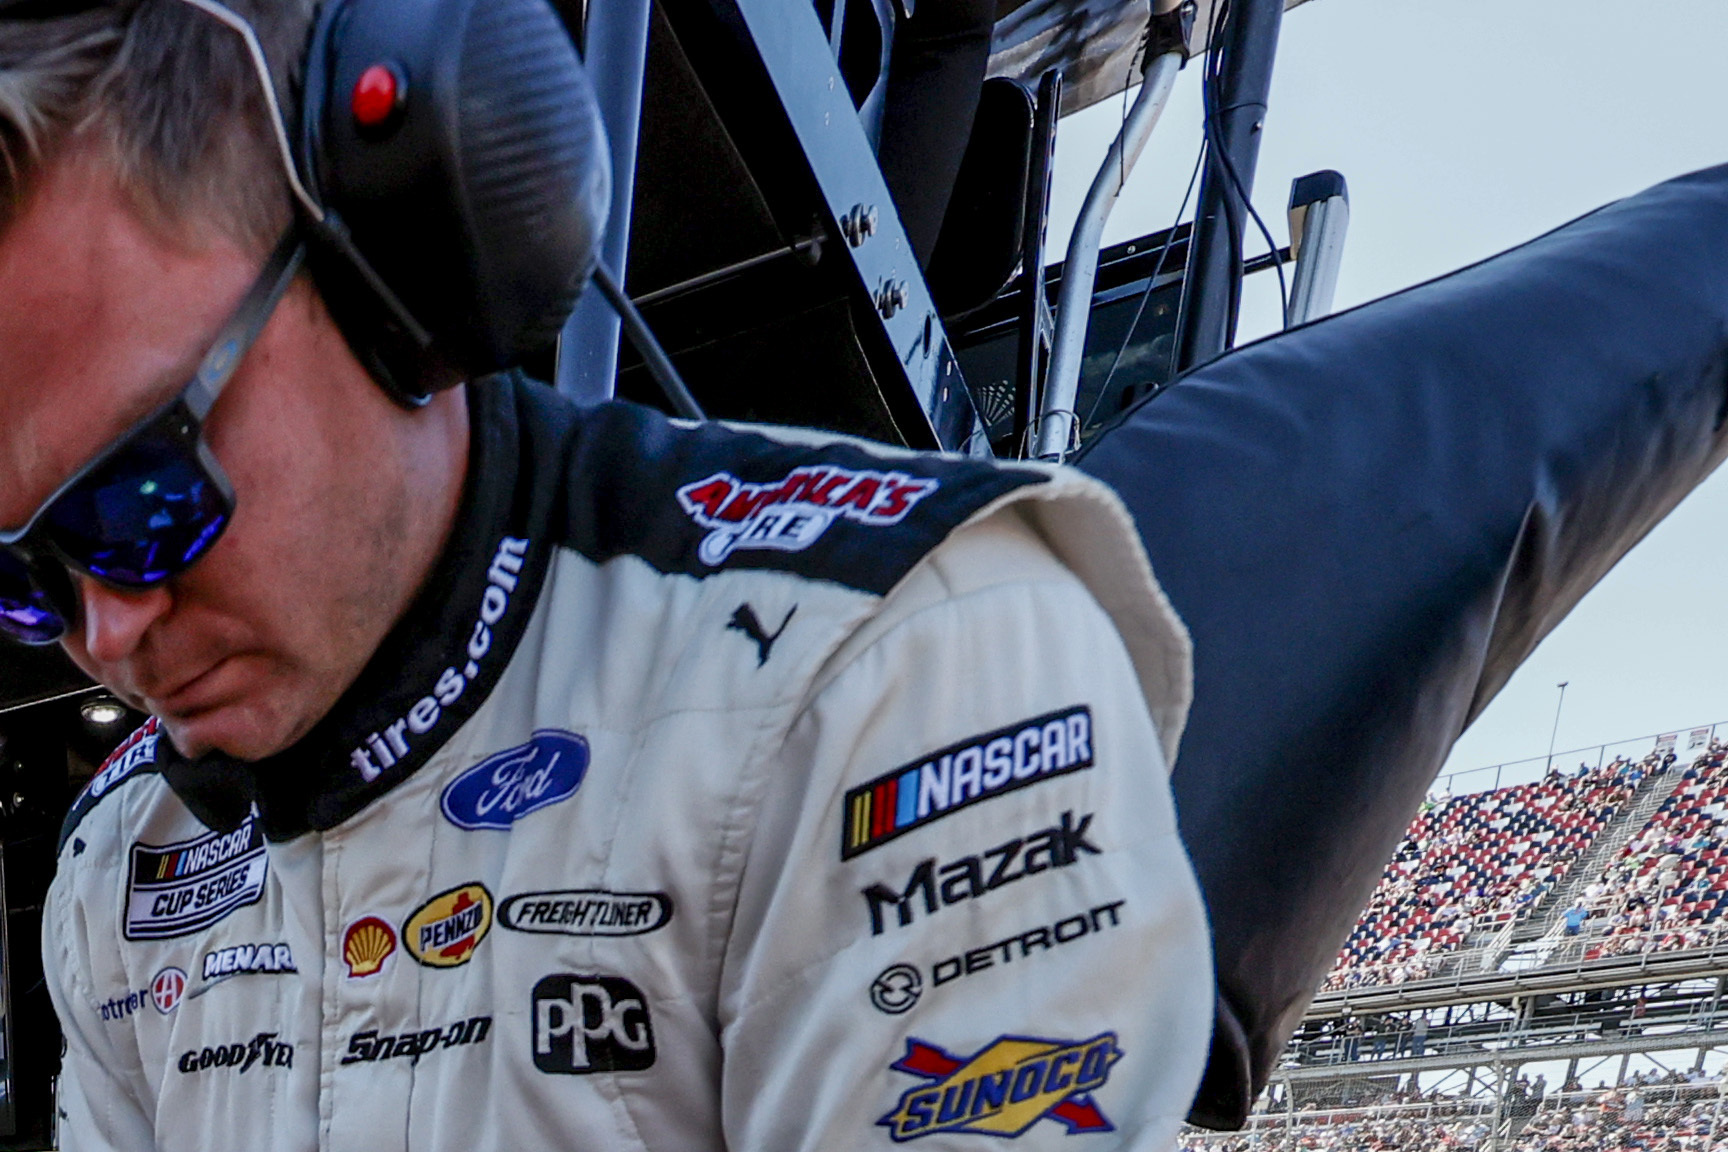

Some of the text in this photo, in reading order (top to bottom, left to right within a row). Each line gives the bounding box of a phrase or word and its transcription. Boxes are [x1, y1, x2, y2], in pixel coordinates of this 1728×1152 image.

[349, 535, 531, 783] tires.com
[915, 710, 1092, 818] NASCAR
[150, 862, 250, 918] CUP SERIES
[182, 822, 254, 874] NASCAR
[860, 808, 1103, 936] Mazak
[202, 944, 298, 980] MENAR
[932, 899, 1127, 989] DETROIT
[340, 1015, 493, 1069] Snap-on
[535, 983, 650, 1068] PPG
[888, 1037, 1114, 1141] SUNOCO
